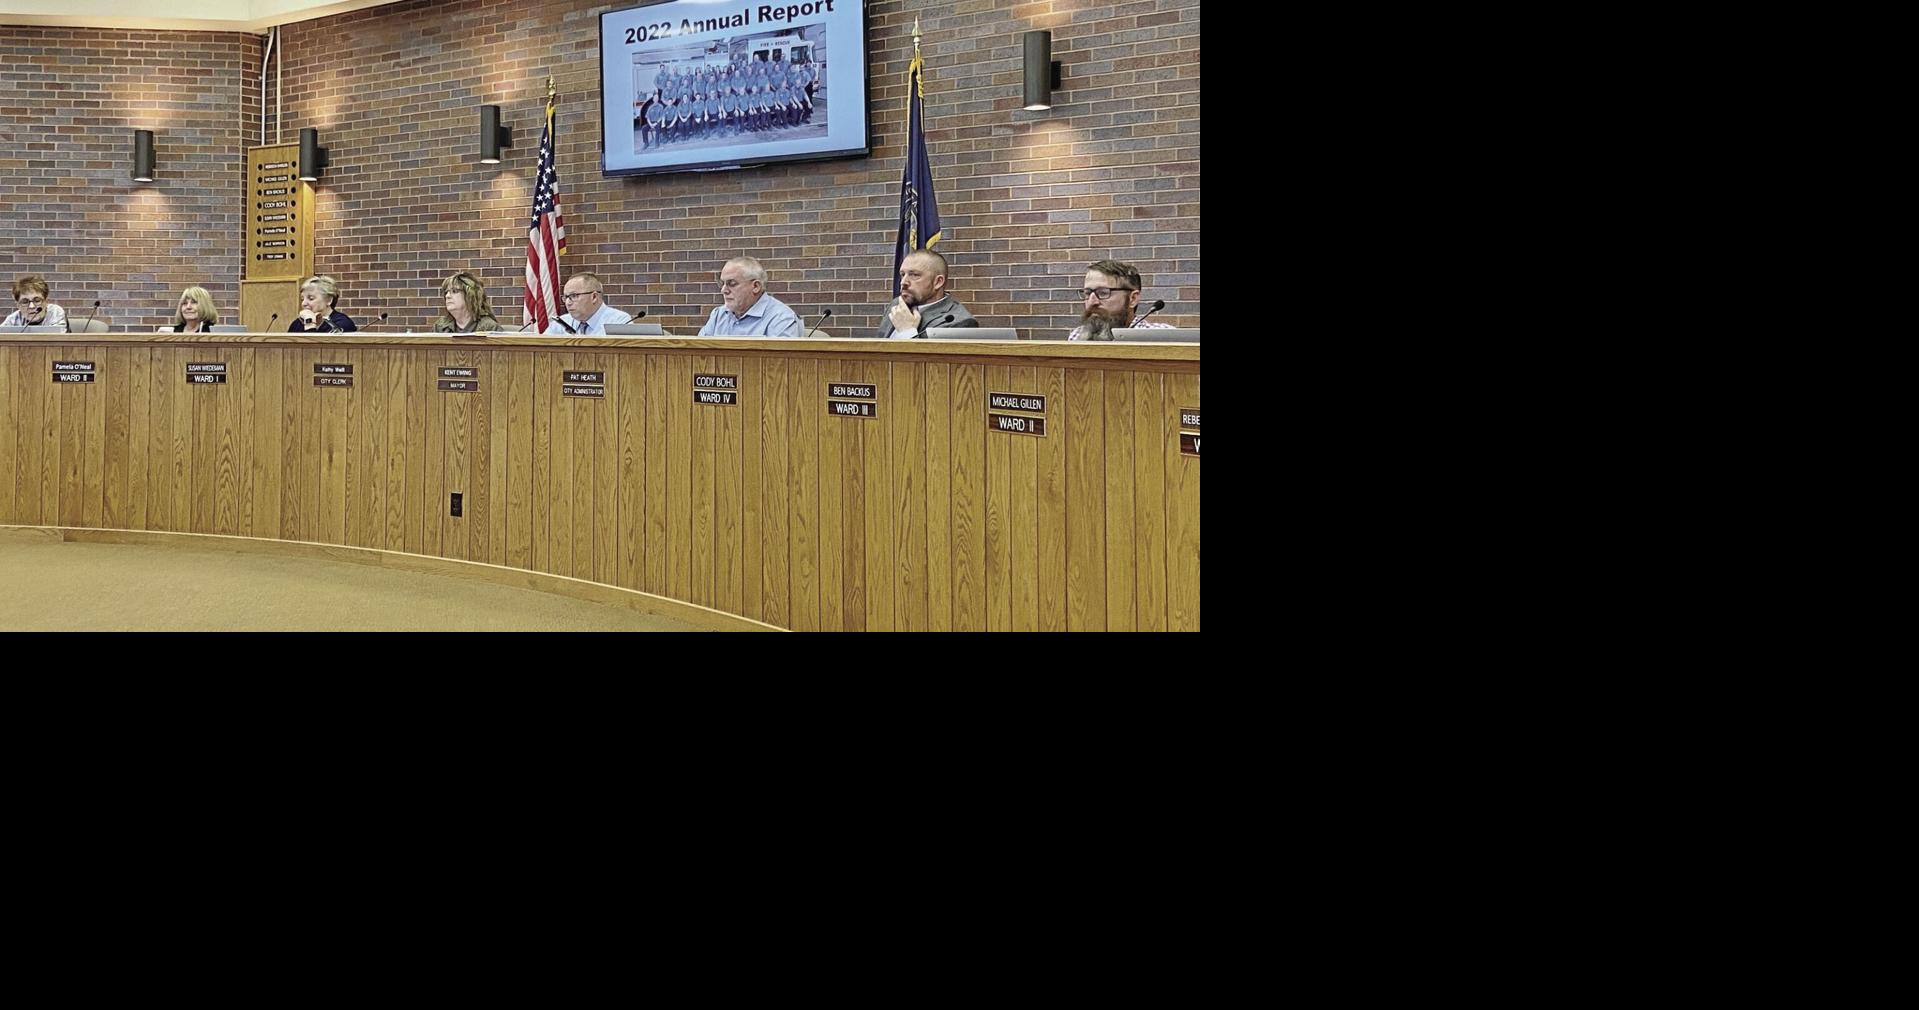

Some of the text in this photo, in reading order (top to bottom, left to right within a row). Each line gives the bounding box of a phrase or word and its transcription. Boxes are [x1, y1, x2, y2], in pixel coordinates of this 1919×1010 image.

[624, 0, 834, 45] 2022 Annual Report
[60, 374, 81, 382] WARD
[194, 375, 214, 383] WARD
[580, 373, 597, 381] HEATH
[695, 376, 736, 388] CODY BOHL
[833, 386, 871, 397] BEN BACKUS
[700, 392, 731, 404] WARD IV
[992, 395, 1042, 410] MICHAEL GILLEN
[835, 402, 869, 416] WARD III
[998, 416, 1034, 433] WARD II
[1182, 413, 1200, 426] REBE
